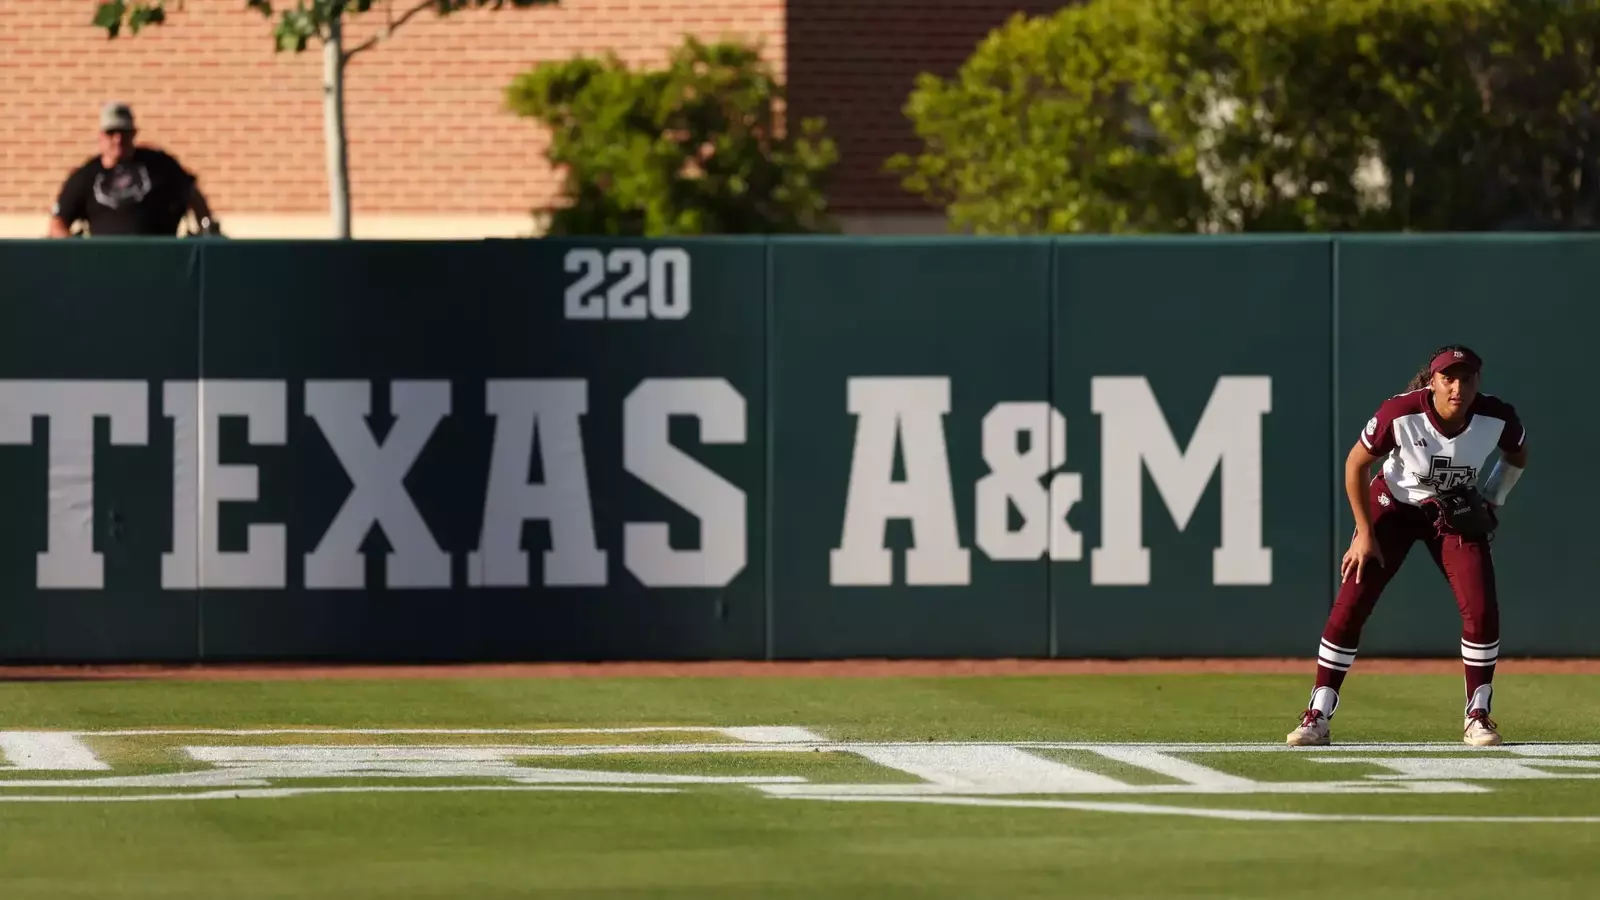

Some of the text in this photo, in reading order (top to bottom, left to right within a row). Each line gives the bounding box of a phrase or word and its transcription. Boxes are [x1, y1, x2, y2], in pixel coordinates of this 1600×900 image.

[564, 248, 691, 319] 220
[0, 375, 1274, 590] TEXAS A&M
